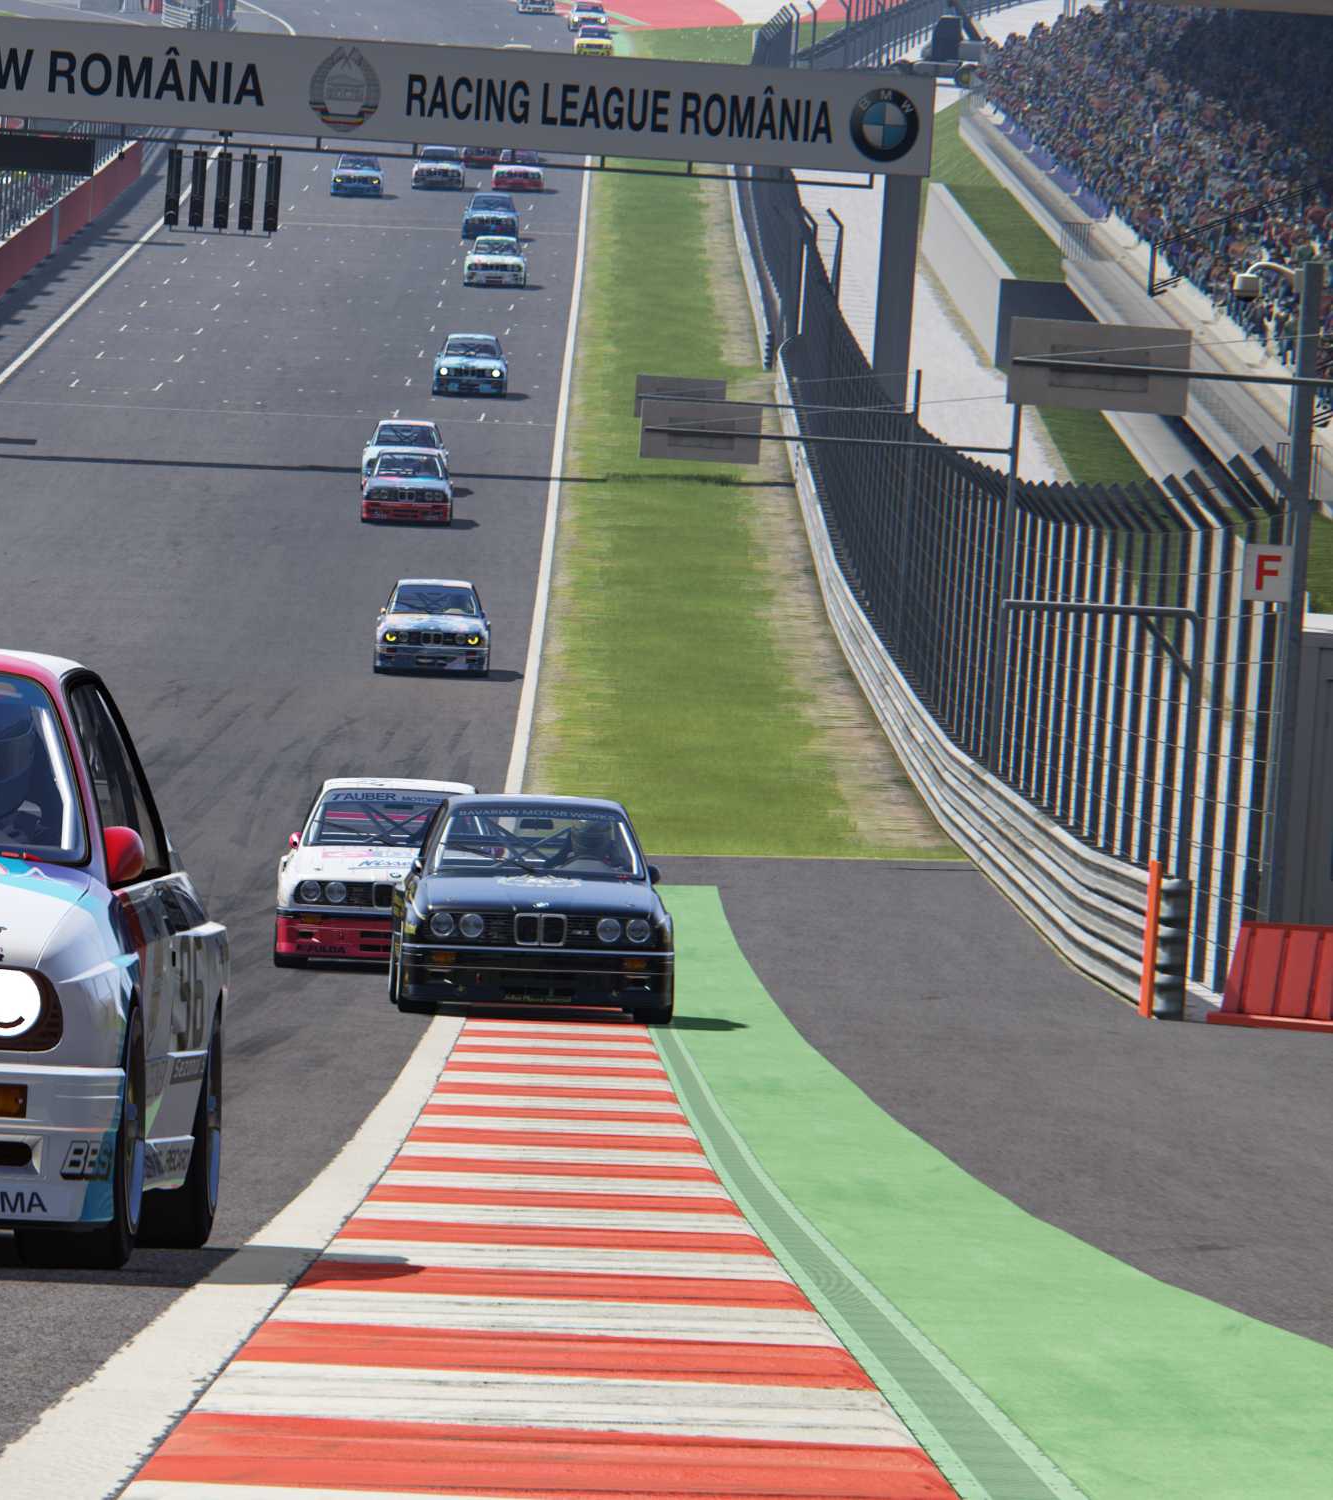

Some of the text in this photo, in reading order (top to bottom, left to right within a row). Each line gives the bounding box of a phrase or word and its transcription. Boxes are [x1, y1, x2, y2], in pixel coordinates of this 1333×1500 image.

[47, 47, 264, 107] ROMÂNIA
[406, 74, 833, 144] RACING LEAGUE ROMÂNIA
[1255, 554, 1282, 591] F
[332, 792, 396, 801] TAUBER
